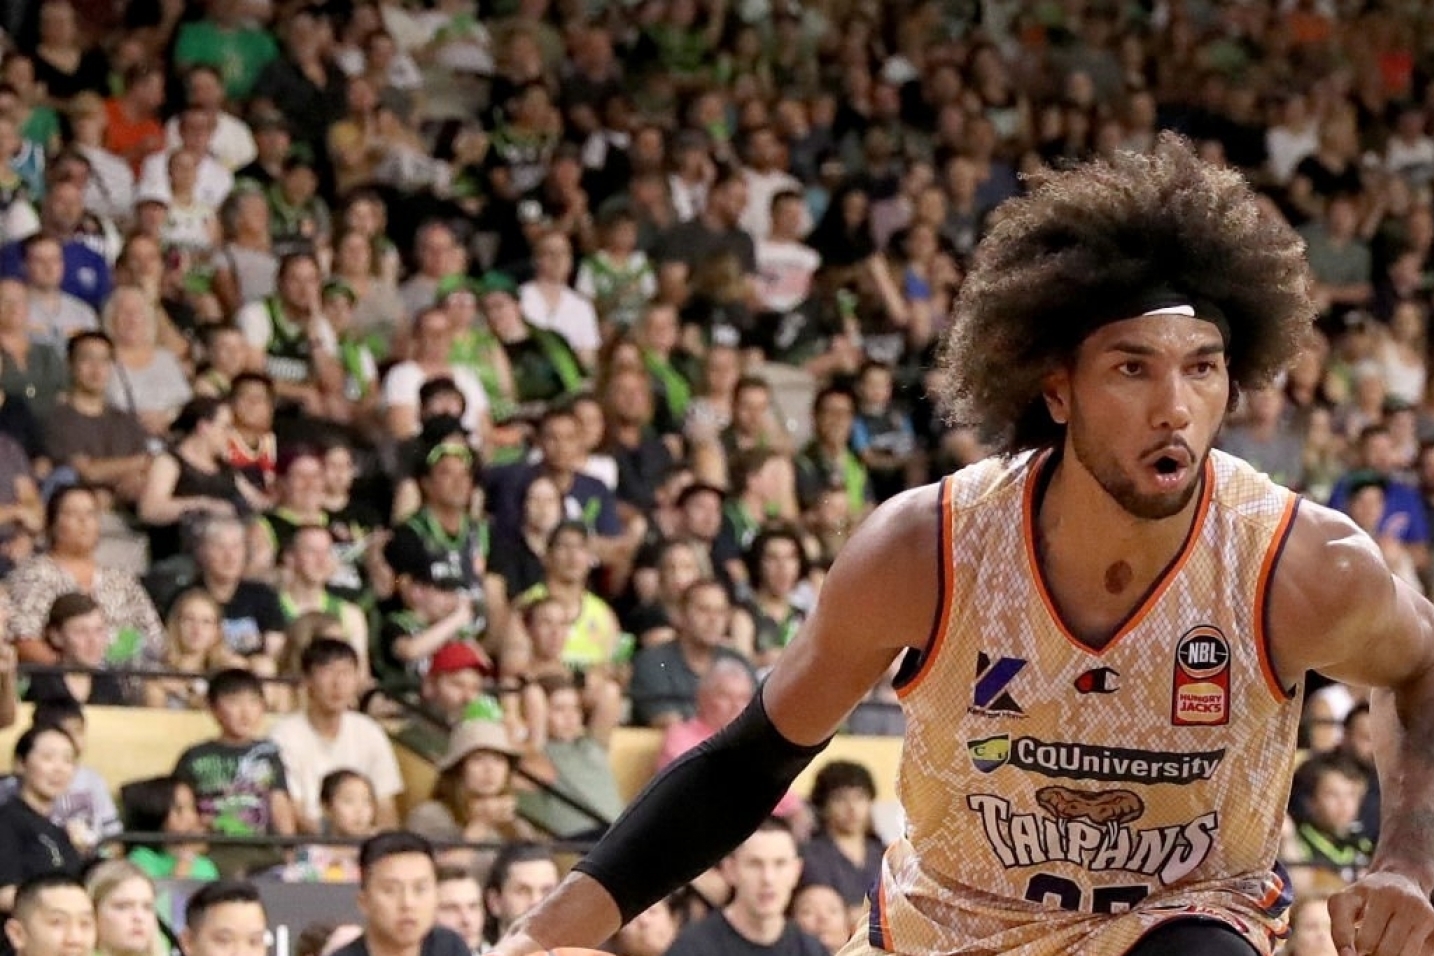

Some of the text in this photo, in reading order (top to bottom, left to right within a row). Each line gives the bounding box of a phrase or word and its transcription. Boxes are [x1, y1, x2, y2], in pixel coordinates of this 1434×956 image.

[1188, 641, 1218, 664] NBL
[1180, 693, 1222, 704] HUNGRY
[1016, 738, 1219, 779] CQUniversity
[966, 794, 1219, 886] TAIPANS
